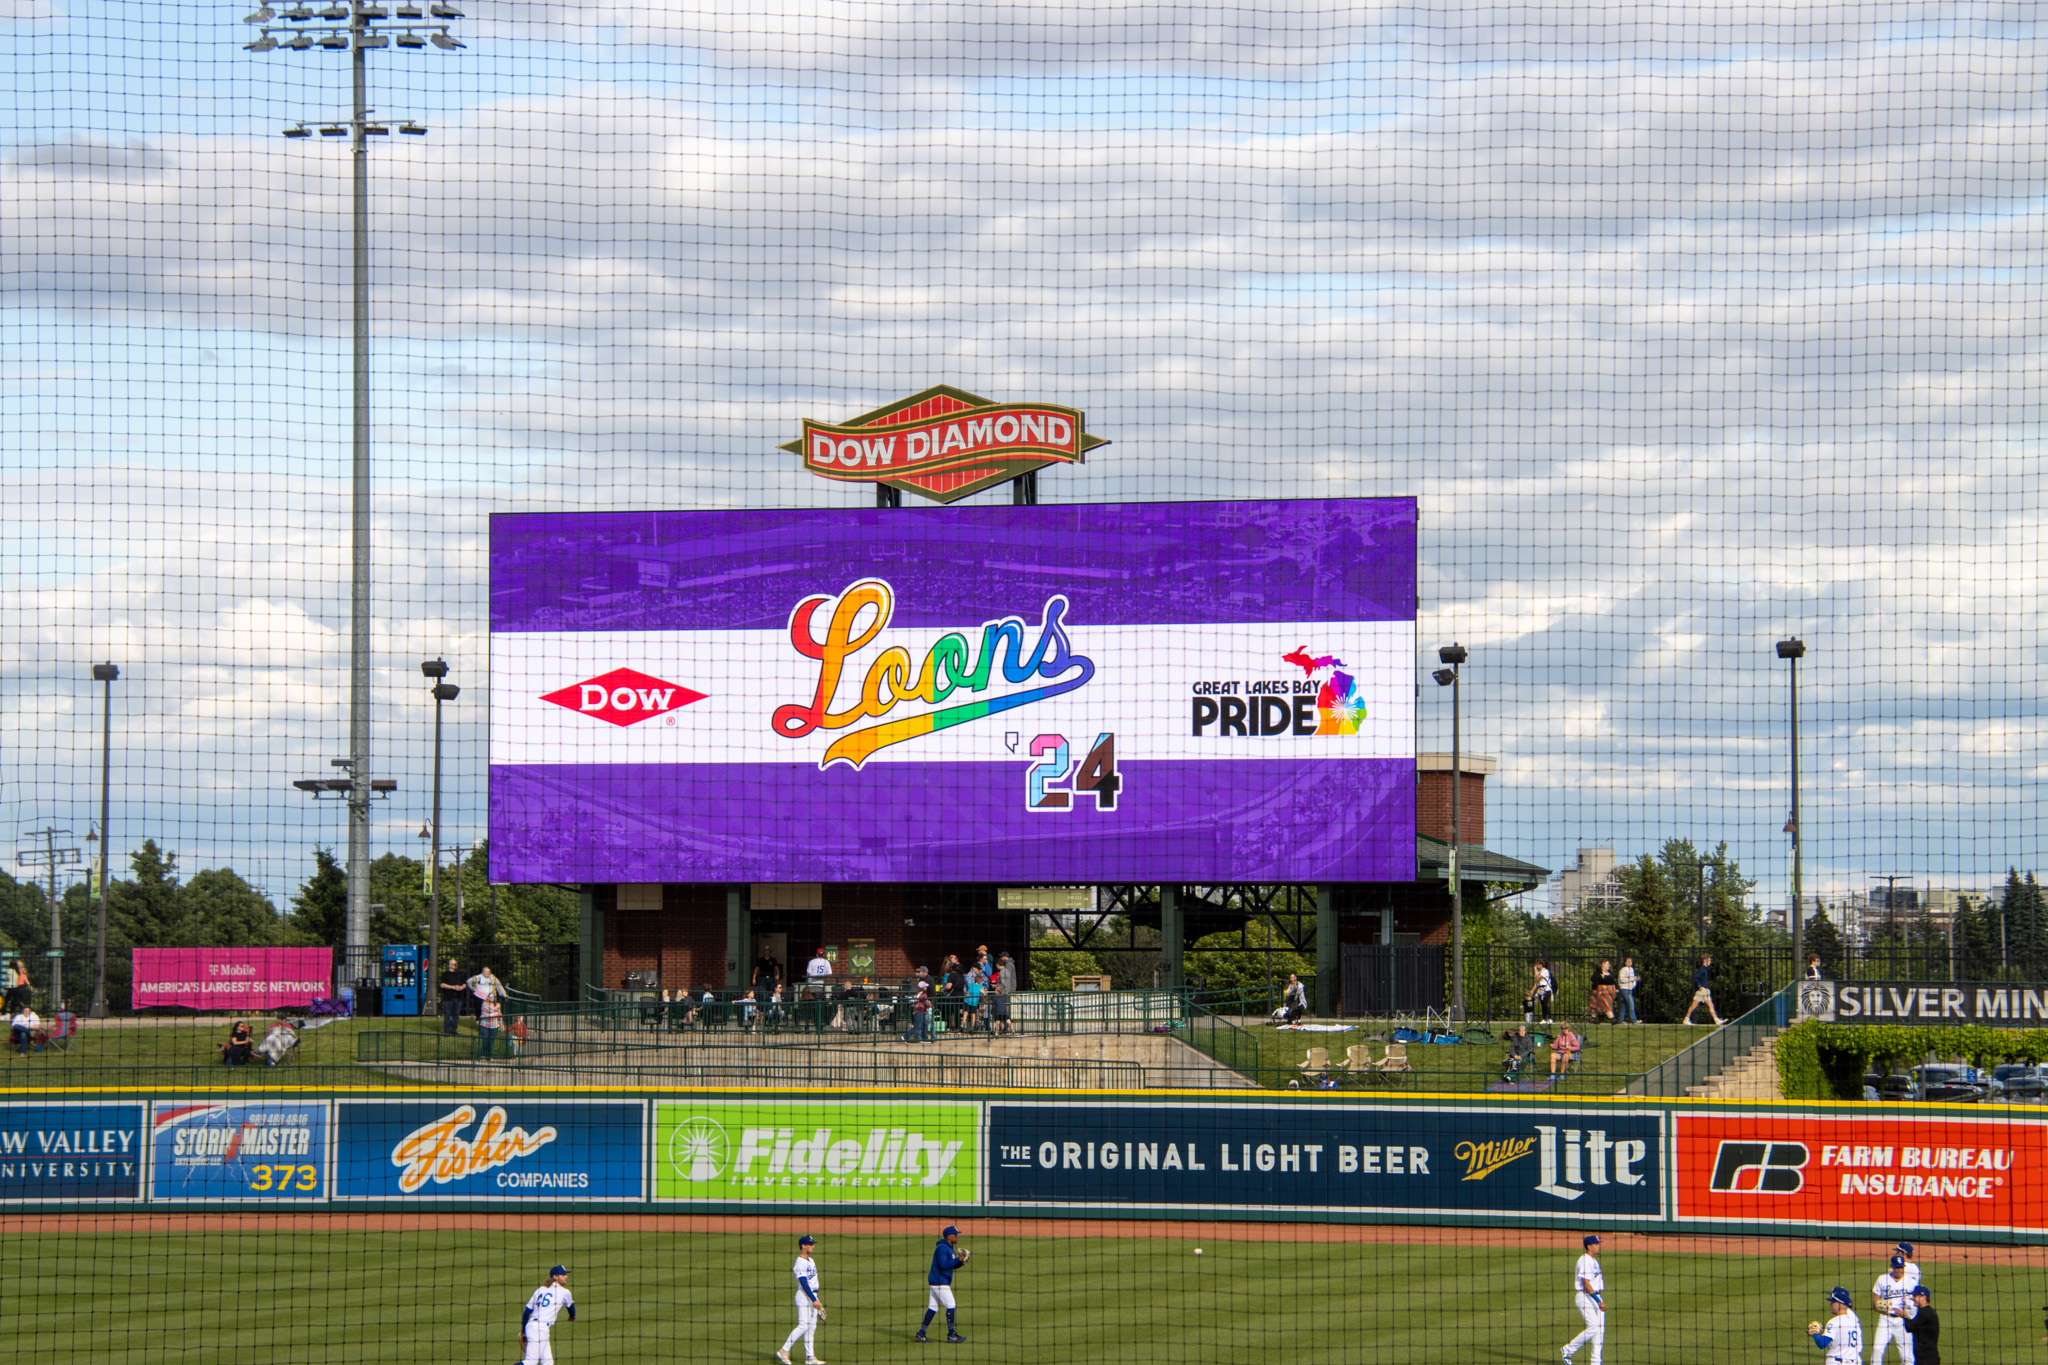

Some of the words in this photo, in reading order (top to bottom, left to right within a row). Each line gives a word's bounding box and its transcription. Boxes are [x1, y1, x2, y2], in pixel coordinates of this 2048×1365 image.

[812, 433, 897, 467] DOW
[906, 414, 1072, 463] DIAMOND
[772, 578, 1096, 745] Loons
[579, 684, 676, 711] DOW
[1192, 681, 1240, 695] GREAT
[1245, 681, 1290, 694] LAKES
[1292, 680, 1321, 694] BAY
[1192, 695, 1319, 737] PRIDE
[220, 964, 256, 976] Mobile
[816, 965, 825, 974] 15
[140, 982, 200, 993] AMERICA'S
[201, 982, 250, 993] LARGEST
[252, 981, 268, 993] 5G
[269, 981, 325, 992] NETWORK
[1839, 986, 1966, 1018] SILVER
[1976, 989, 2048, 1018] MIN
[37, 1130, 134, 1153] VALLEY
[173, 1128, 237, 1156] STORM
[240, 1128, 310, 1155] MASTER
[391, 1105, 557, 1193] Fisher
[733, 1128, 964, 1187] Fidelity
[1001, 1145, 1032, 1160] THE
[1038, 1141, 1206, 1171] ORIGINAL
[1221, 1143, 1323, 1173] LIGHT
[1338, 1145, 1430, 1175] BEER
[1454, 1136, 1538, 1177] Miller
[1534, 1126, 1646, 1201] Lite
[1821, 1145, 1894, 1169] FARM
[1901, 1147, 2014, 1171] BUREAU
[251, 1165, 317, 1191] 373
[496, 1172, 589, 1188] COMPANIES
[731, 1176, 913, 1188] INVESTMENTS
[1847, 1330, 1858, 1348] 19
